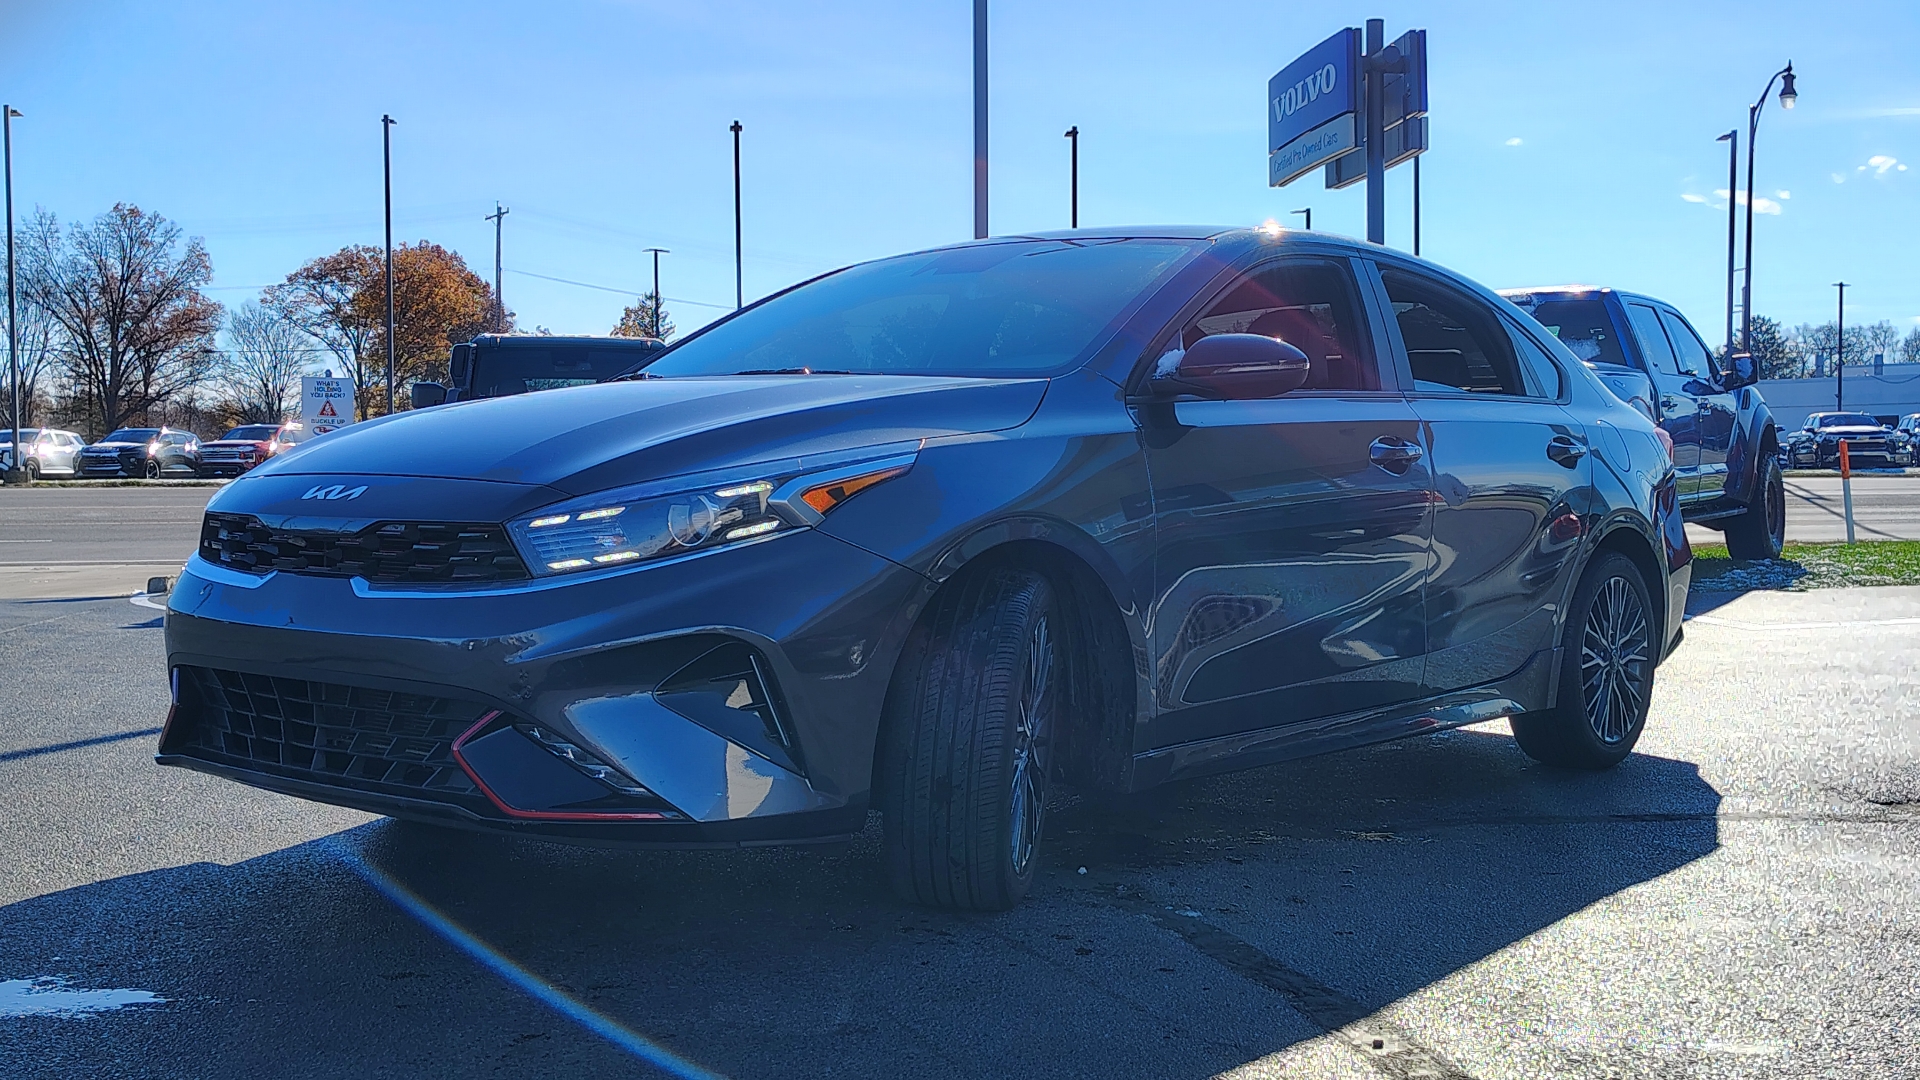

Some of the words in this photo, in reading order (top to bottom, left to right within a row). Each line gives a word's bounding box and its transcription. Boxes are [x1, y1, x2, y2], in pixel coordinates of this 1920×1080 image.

[1272, 63, 1336, 123] VOLVO
[1273, 151, 1293, 175] Certified
[1292, 149, 1302, 163] Pre
[1302, 136, 1322, 158] Owned
[1323, 132, 1338, 148] Cars
[301, 485, 369, 501] KIA
